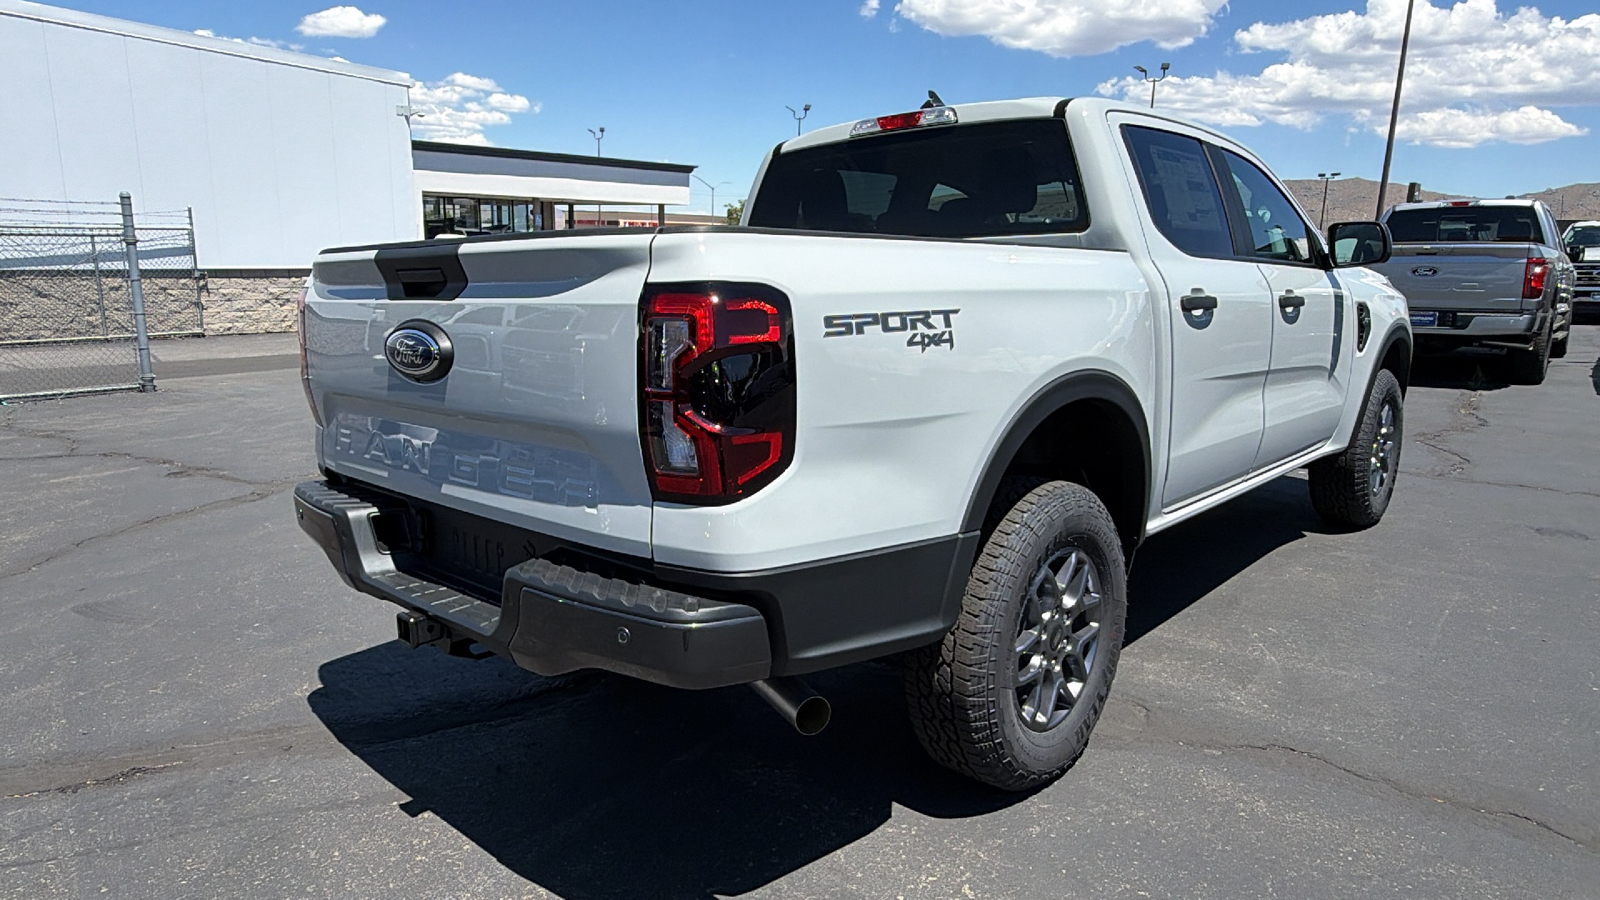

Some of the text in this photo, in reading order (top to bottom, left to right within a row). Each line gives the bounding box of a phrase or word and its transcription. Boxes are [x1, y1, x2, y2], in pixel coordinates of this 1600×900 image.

[1414, 267, 1434, 276] Ford
[823, 308, 961, 338] SPORT
[394, 339, 423, 364] Ford
[906, 330, 954, 354] 4x4
[335, 428, 598, 512] RANGER
